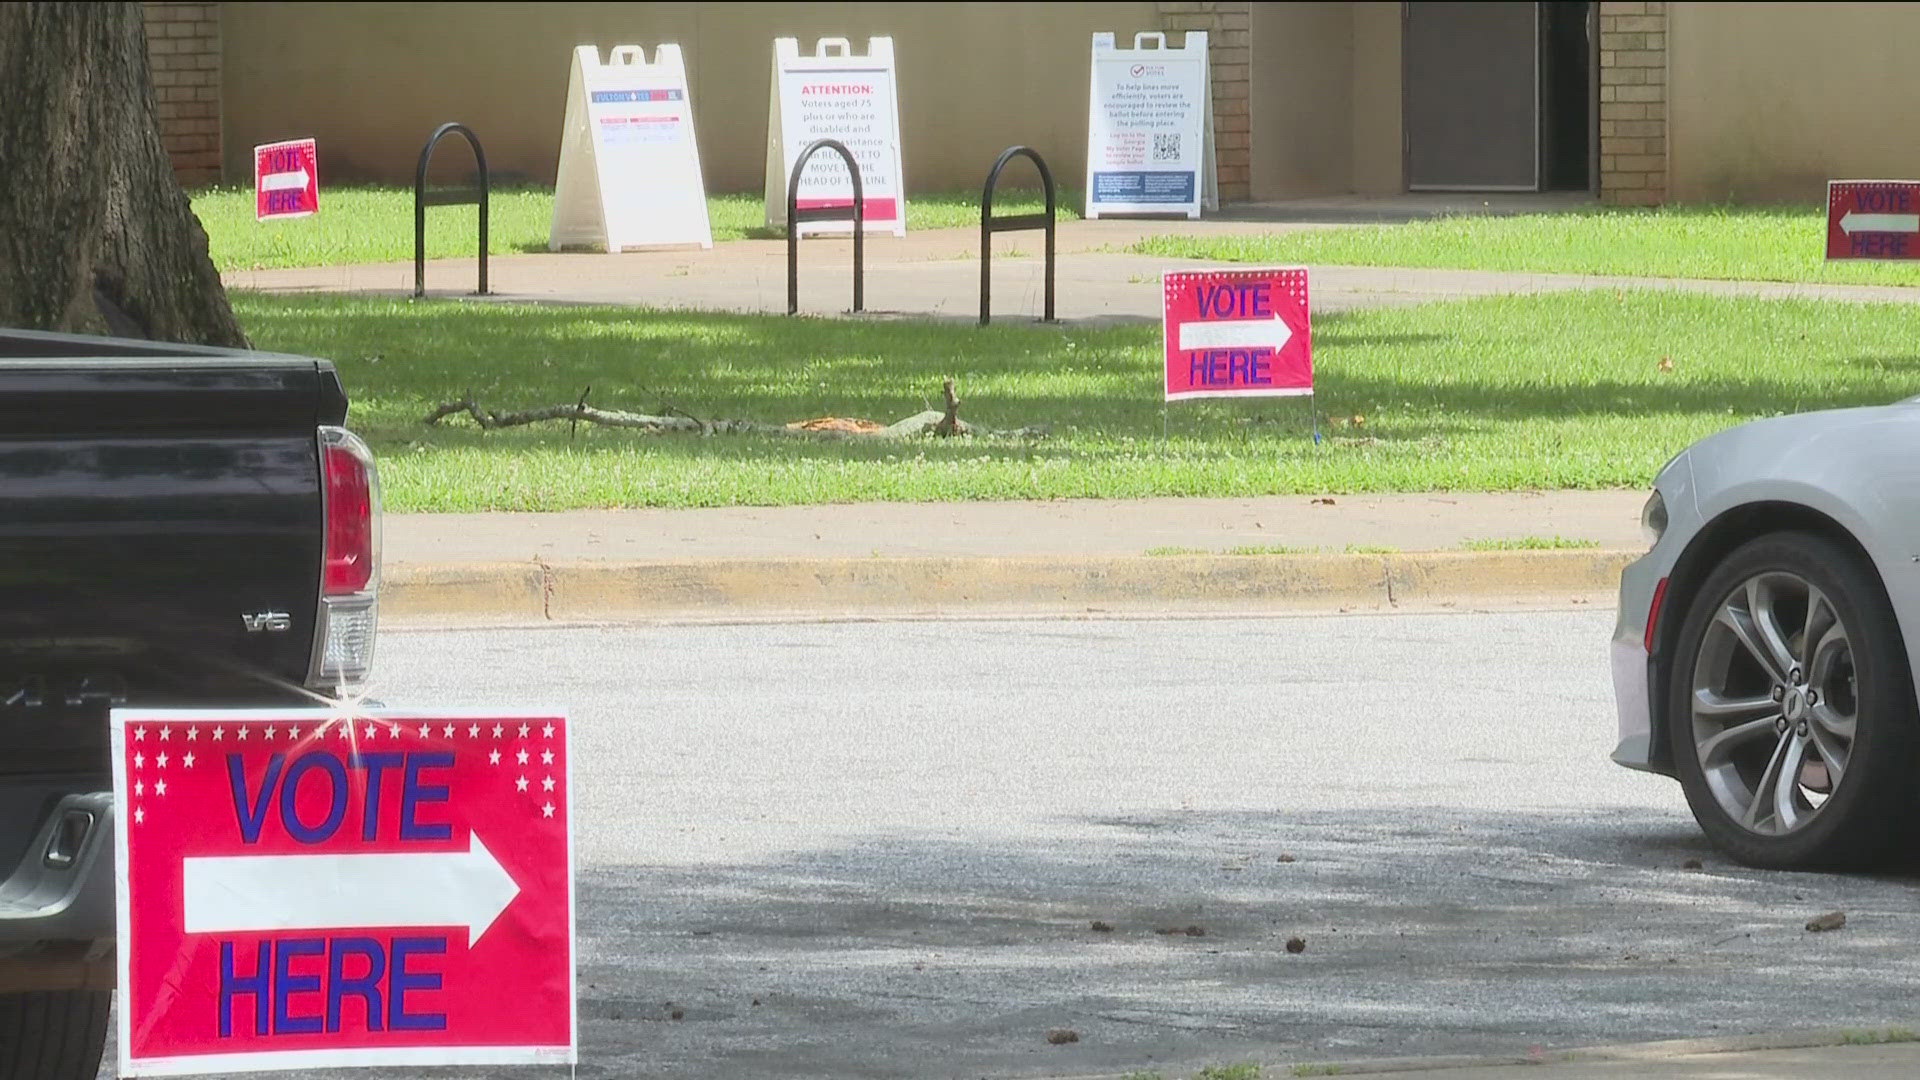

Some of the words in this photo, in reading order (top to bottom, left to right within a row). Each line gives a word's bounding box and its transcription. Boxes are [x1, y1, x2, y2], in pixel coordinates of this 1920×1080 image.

[802, 85, 874, 94] ATTENTION:
[1126, 83, 1141, 91] help
[801, 99, 832, 107] Voters
[834, 99, 858, 108] aged
[861, 99, 872, 107] 75
[803, 112, 823, 122] plus
[838, 112, 858, 120] who
[1130, 120, 1154, 128] polling
[809, 124, 850, 133] disabled
[852, 124, 871, 133] and
[268, 149, 301, 172] VOTE
[868, 150, 881, 159] TO
[810, 163, 839, 172] MOVE
[862, 163, 875, 172] HE
[800, 176, 828, 186] HEAD
[829, 176, 844, 185] OF
[866, 176, 887, 185] LINE
[267, 189, 302, 213] HERE
[1855, 188, 1909, 211] VOTE
[1851, 232, 1909, 256] HERE
[1197, 283, 1271, 318] VOTE
[1190, 349, 1272, 386] HERE
[241, 611, 291, 632] V6
[226, 750, 456, 845] VOTE
[218, 937, 447, 1039] HERE
